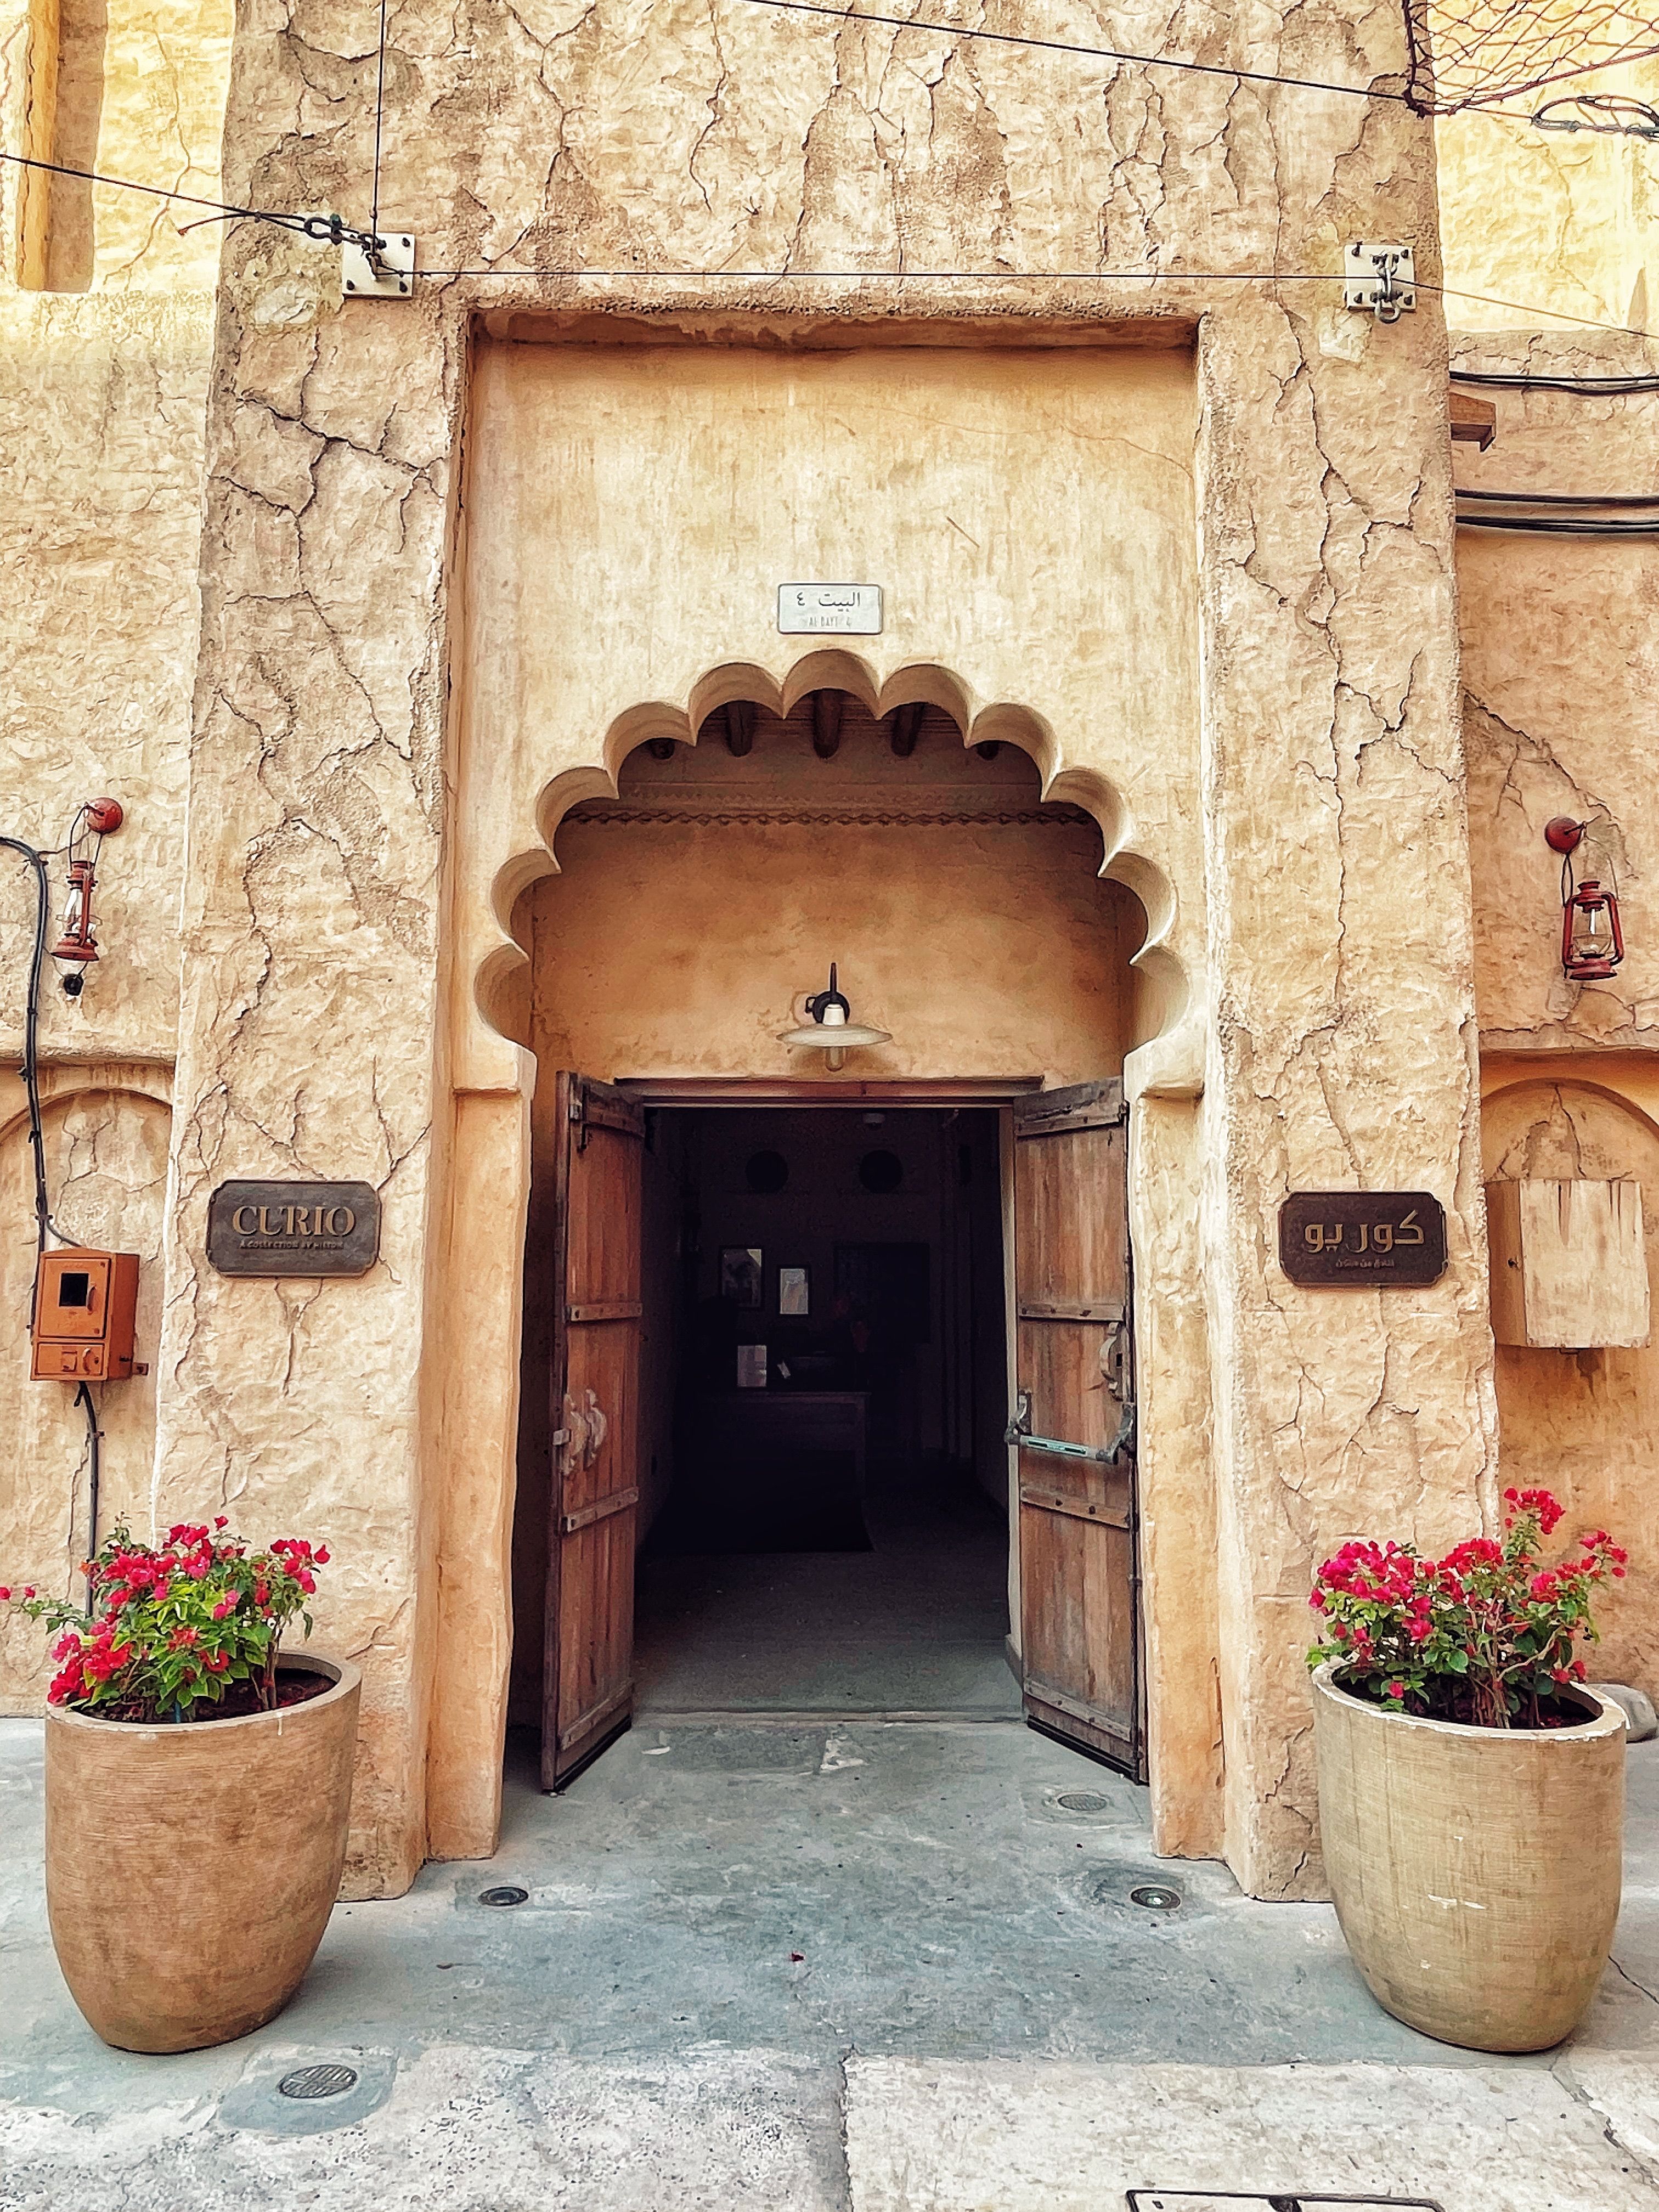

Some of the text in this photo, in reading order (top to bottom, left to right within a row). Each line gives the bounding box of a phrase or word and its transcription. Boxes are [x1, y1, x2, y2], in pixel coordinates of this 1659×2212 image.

[797, 591, 860, 612] البيت ٤
[232, 1205, 356, 1237] CURIO
[1302, 1209, 1424, 1254] كوريو
